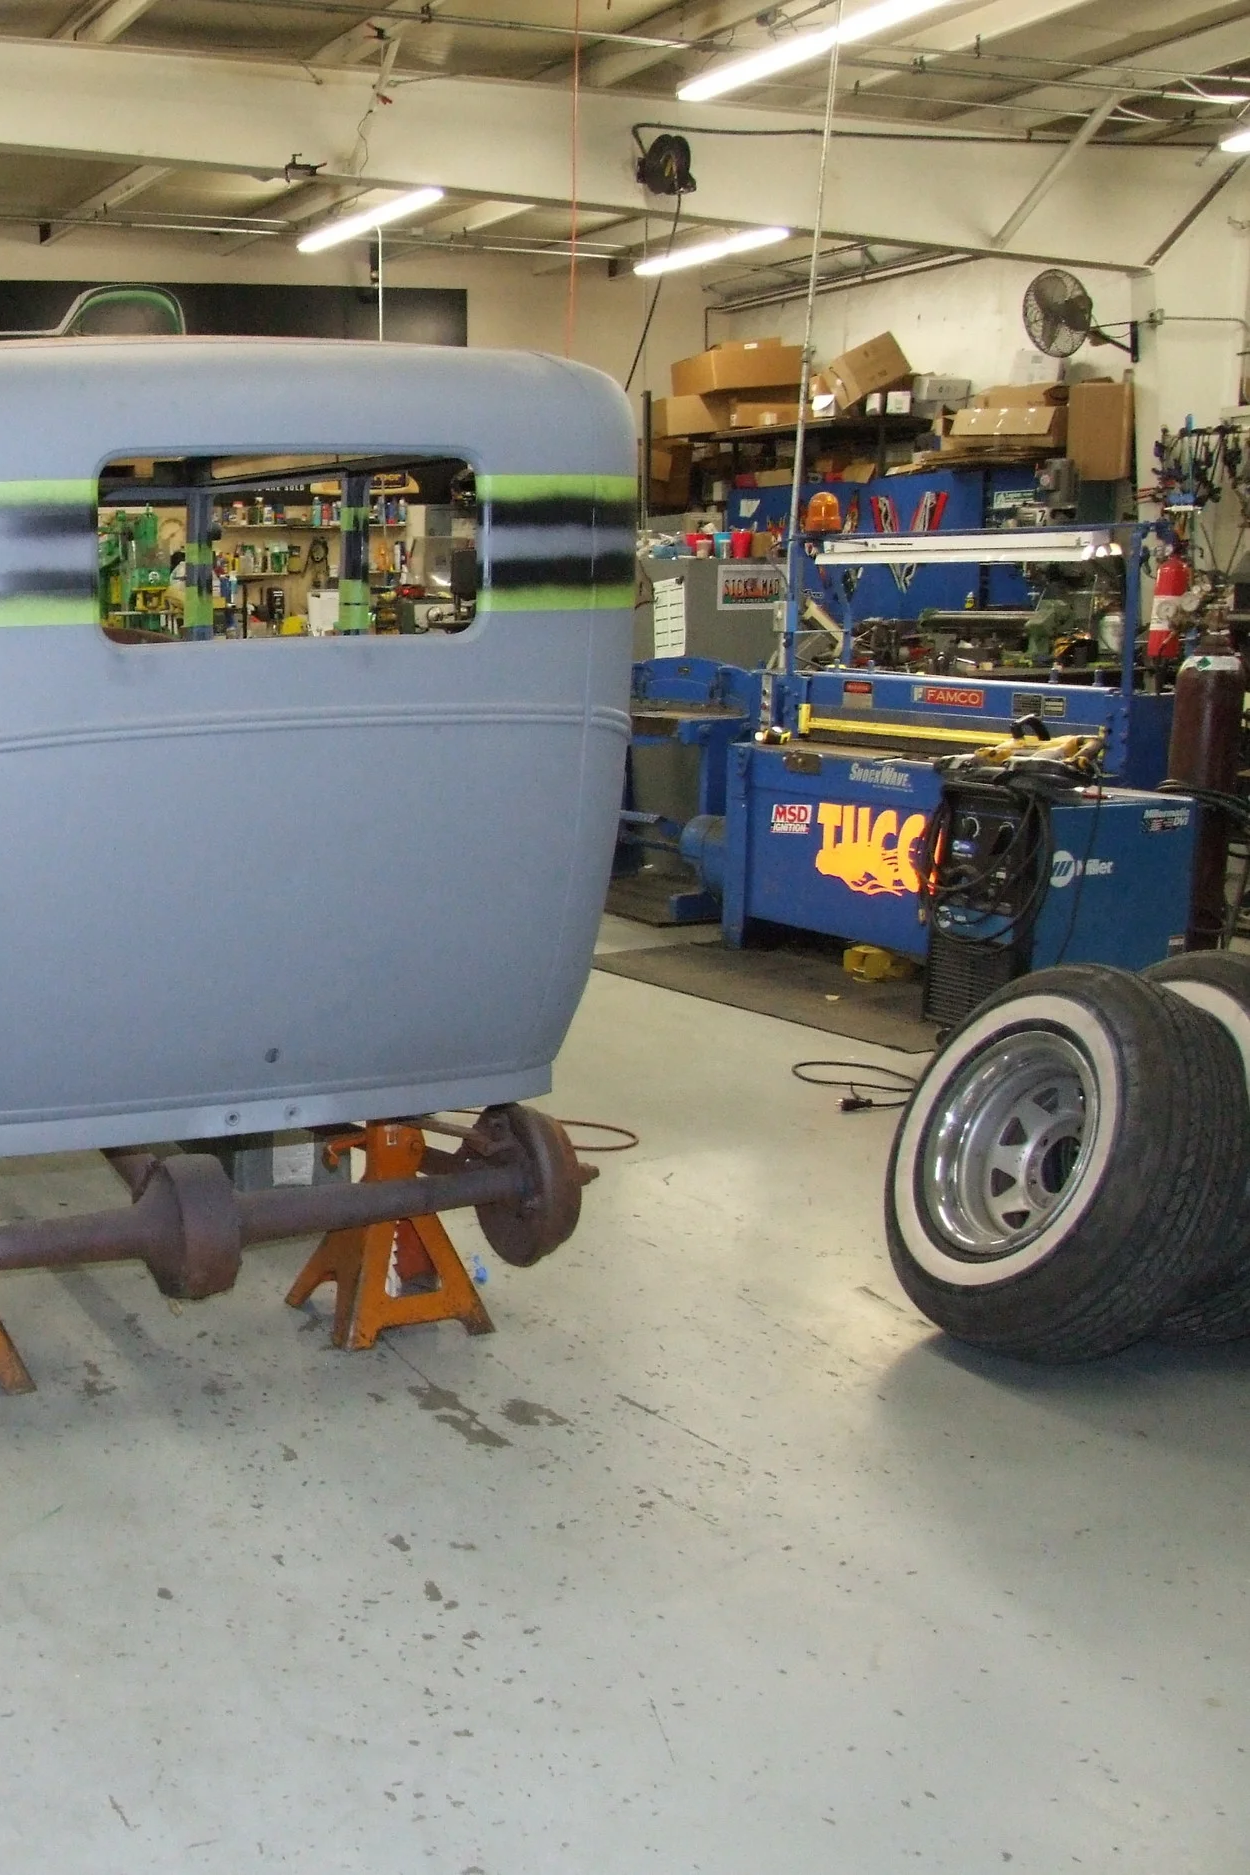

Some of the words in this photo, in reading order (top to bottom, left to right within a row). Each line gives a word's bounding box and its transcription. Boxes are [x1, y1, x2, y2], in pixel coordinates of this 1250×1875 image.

[927, 688, 981, 706] FAMCO
[773, 805, 808, 823] MSD
[772, 822, 808, 833] IGNITION
